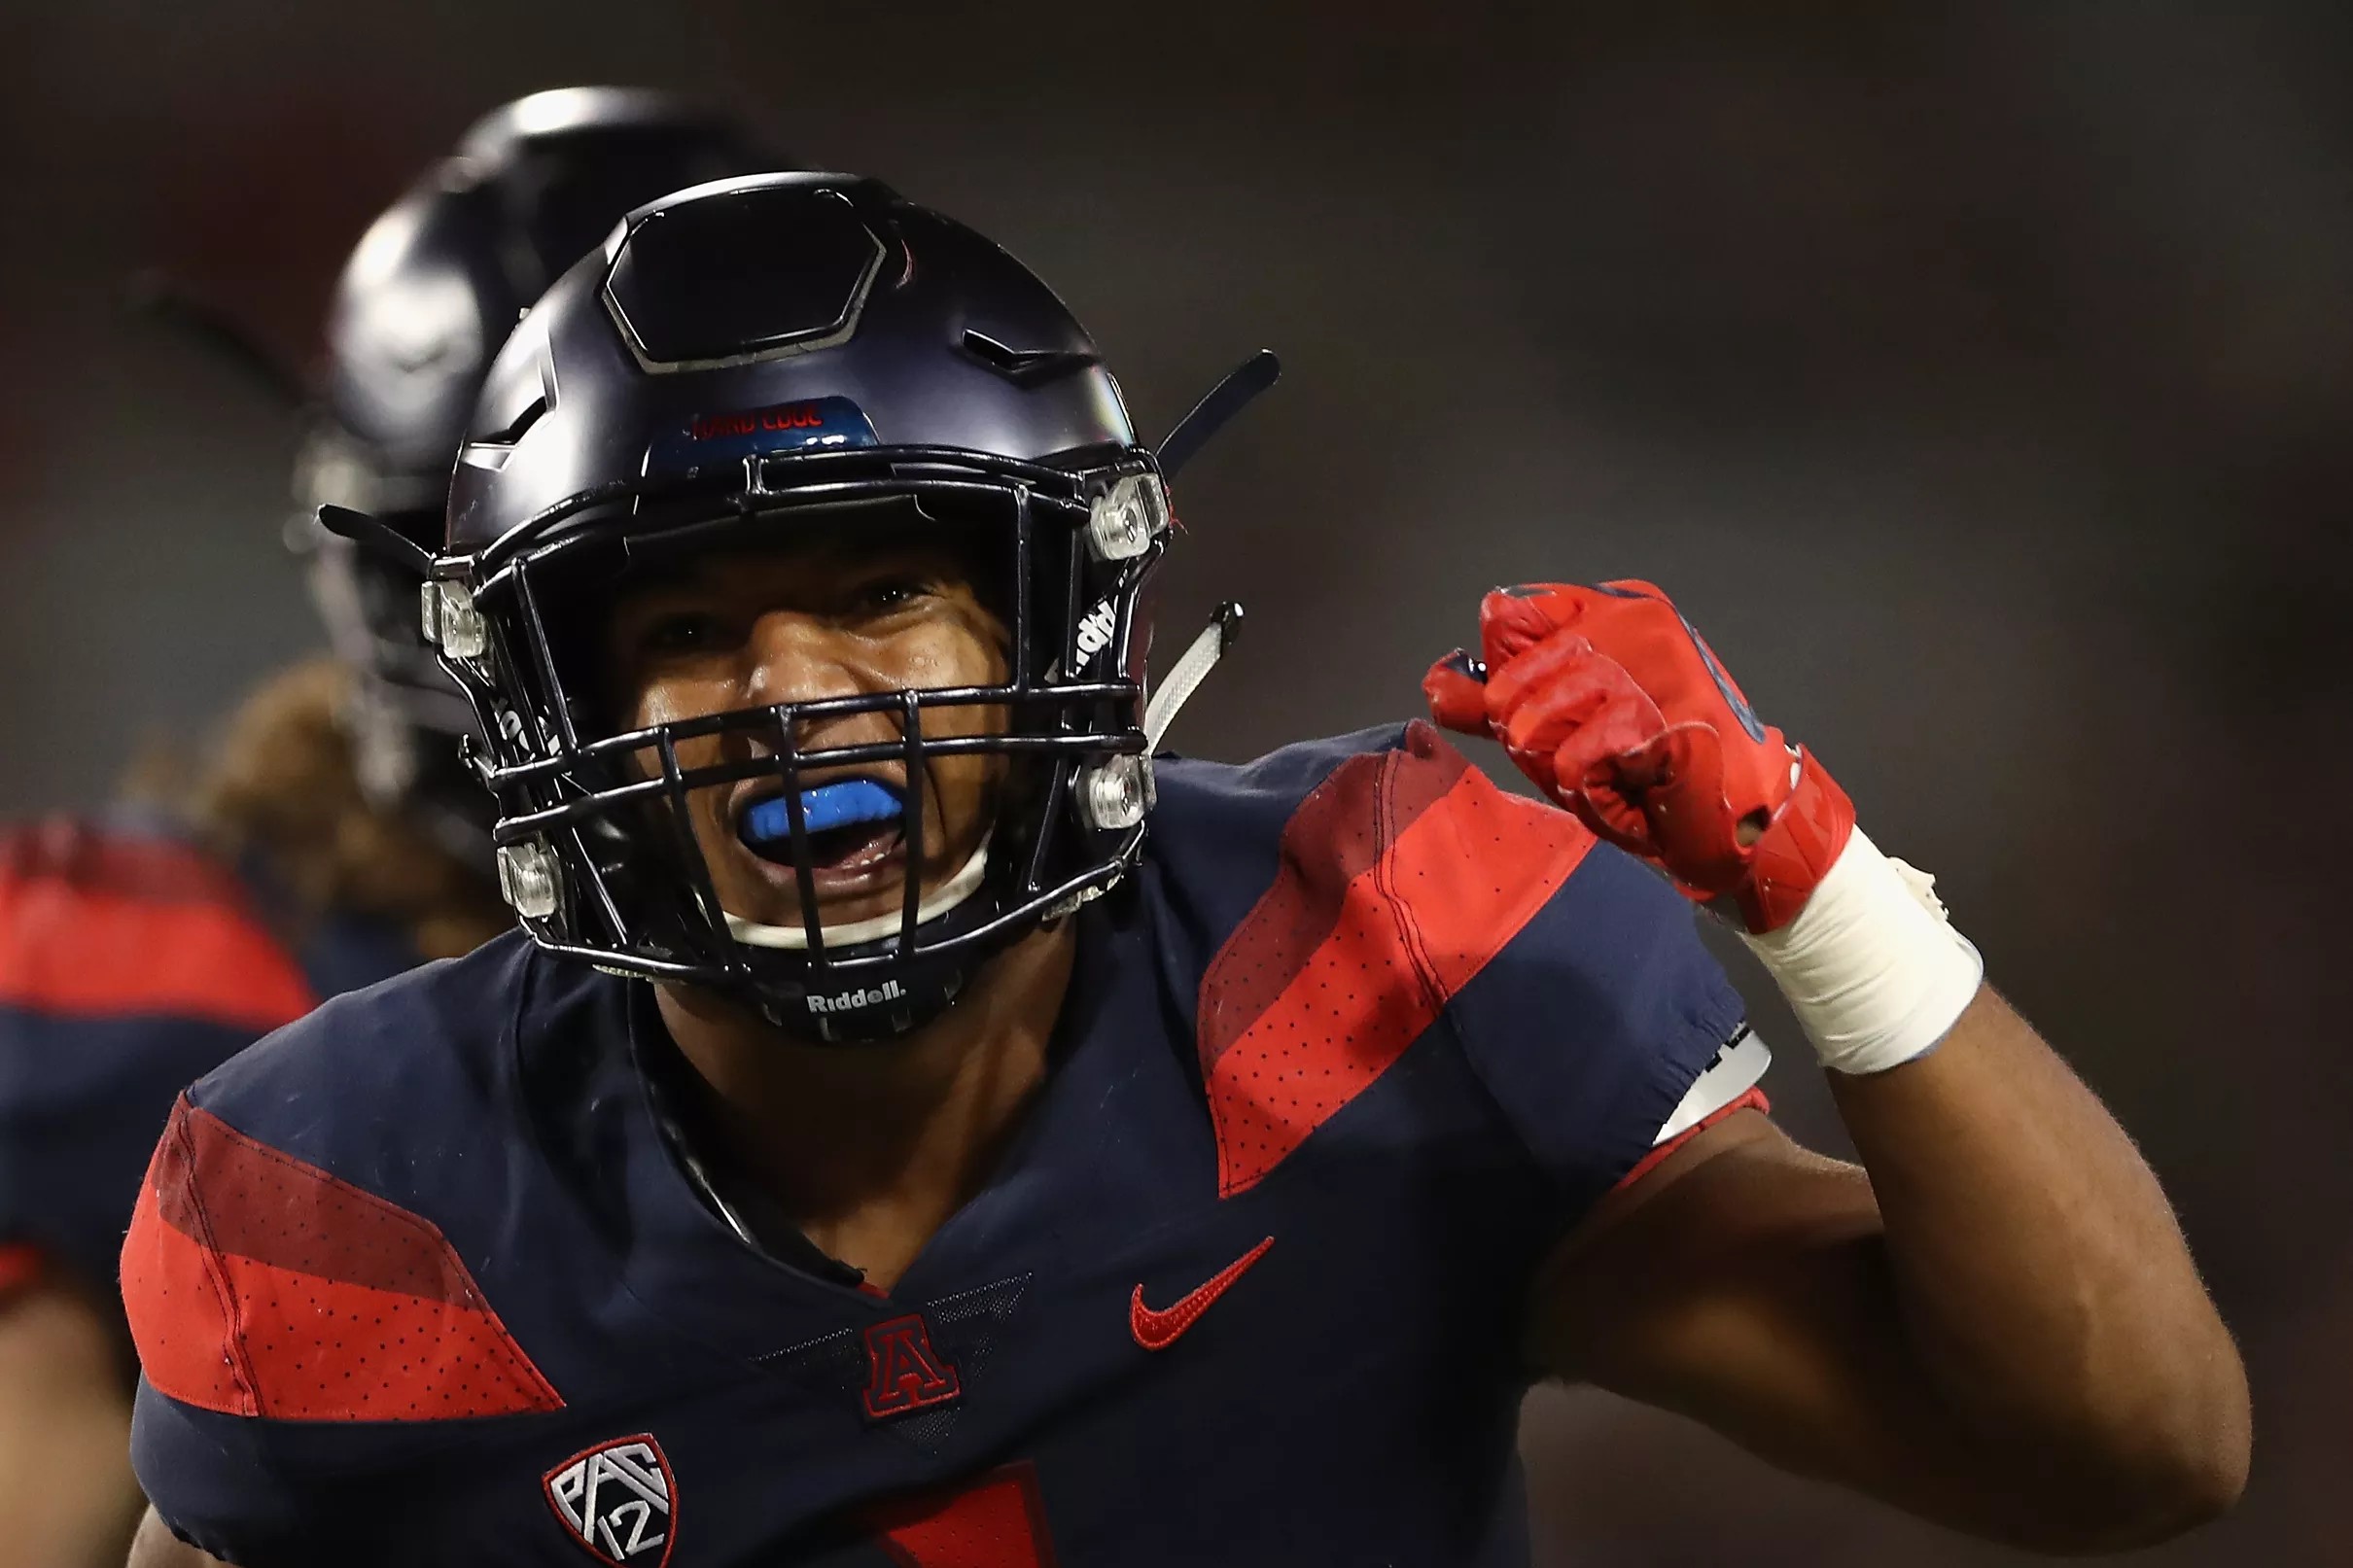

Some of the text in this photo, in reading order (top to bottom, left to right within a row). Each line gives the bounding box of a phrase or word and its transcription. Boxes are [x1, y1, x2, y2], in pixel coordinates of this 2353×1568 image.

[862, 1313, 962, 1417] A
[550, 1443, 669, 1544] PAC
[597, 1500, 664, 1561] 12
